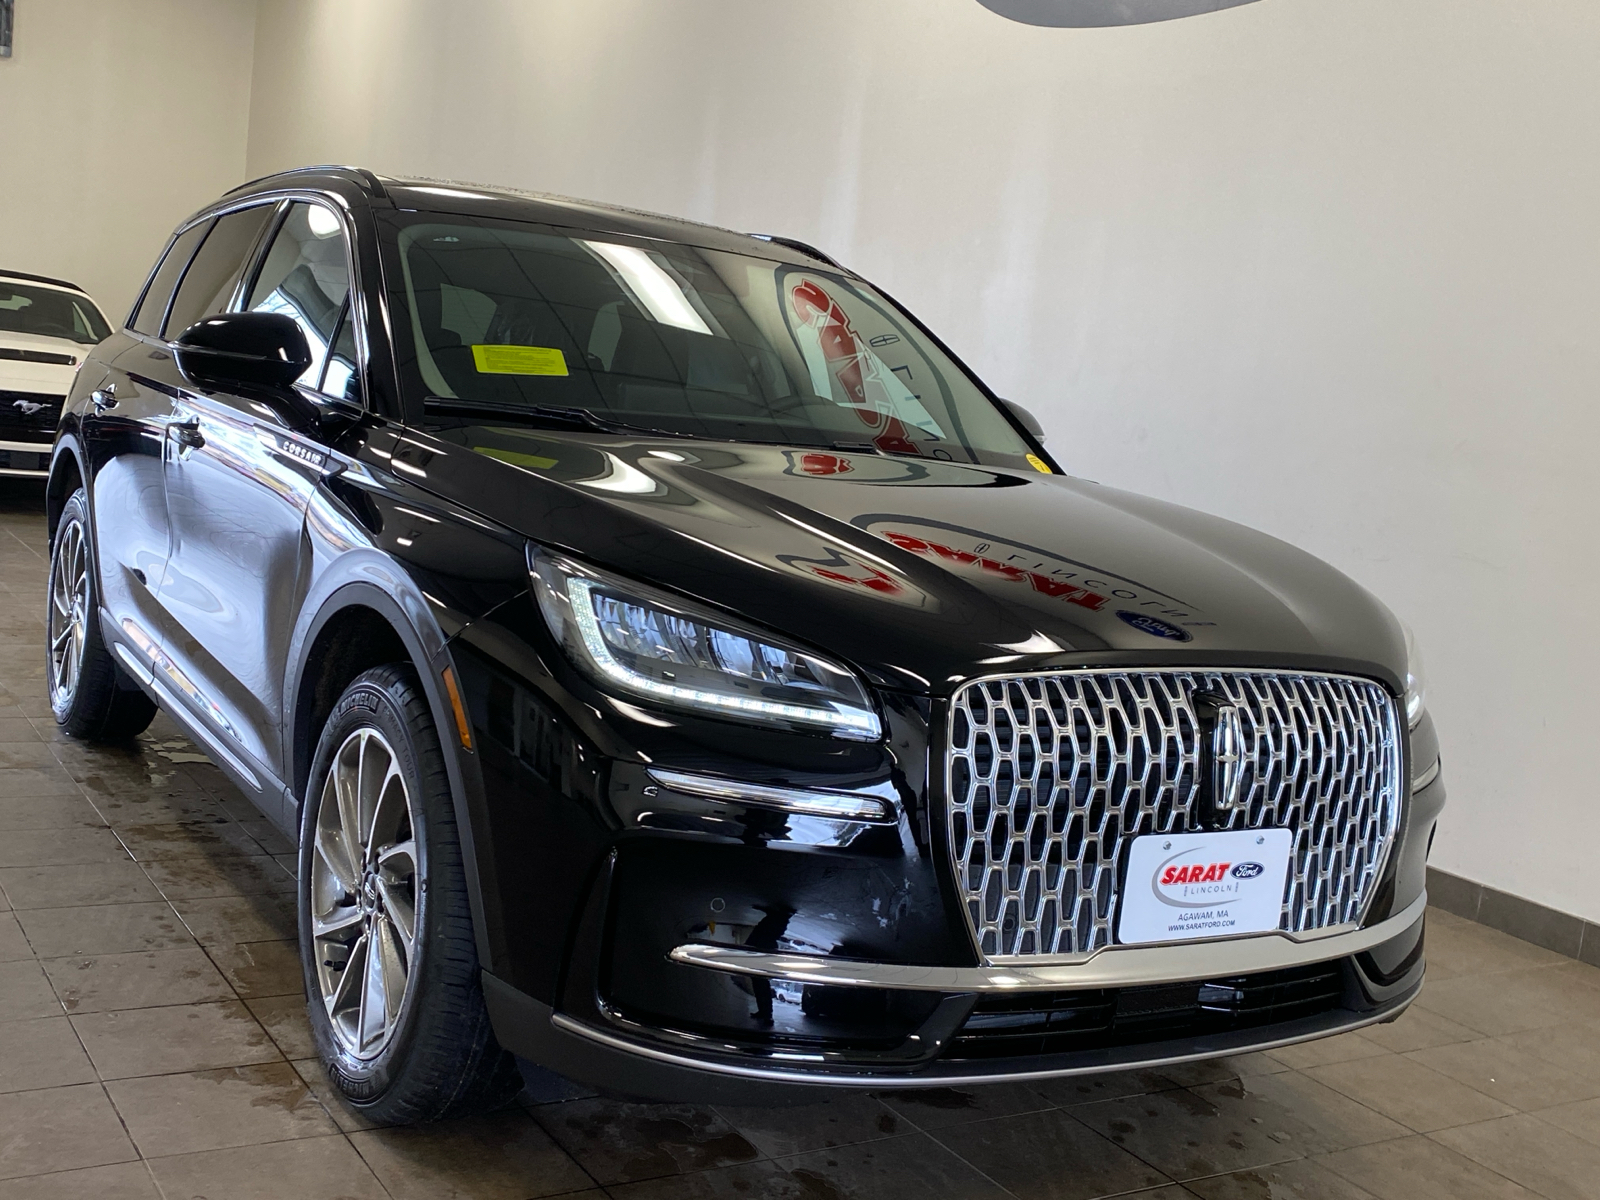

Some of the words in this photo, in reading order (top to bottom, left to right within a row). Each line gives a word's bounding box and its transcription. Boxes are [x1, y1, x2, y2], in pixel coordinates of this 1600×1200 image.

[282, 440, 322, 465] CORSAIR
[340, 692, 379, 716] MICHELIN
[1160, 862, 1232, 885] SARAT
[1191, 885, 1232, 895] LINCOLN
[1177, 911, 1215, 922] AGAWAM,
[1216, 909, 1229, 918] MA
[1168, 920, 1235, 931] WWW.SARATFORD.COM
